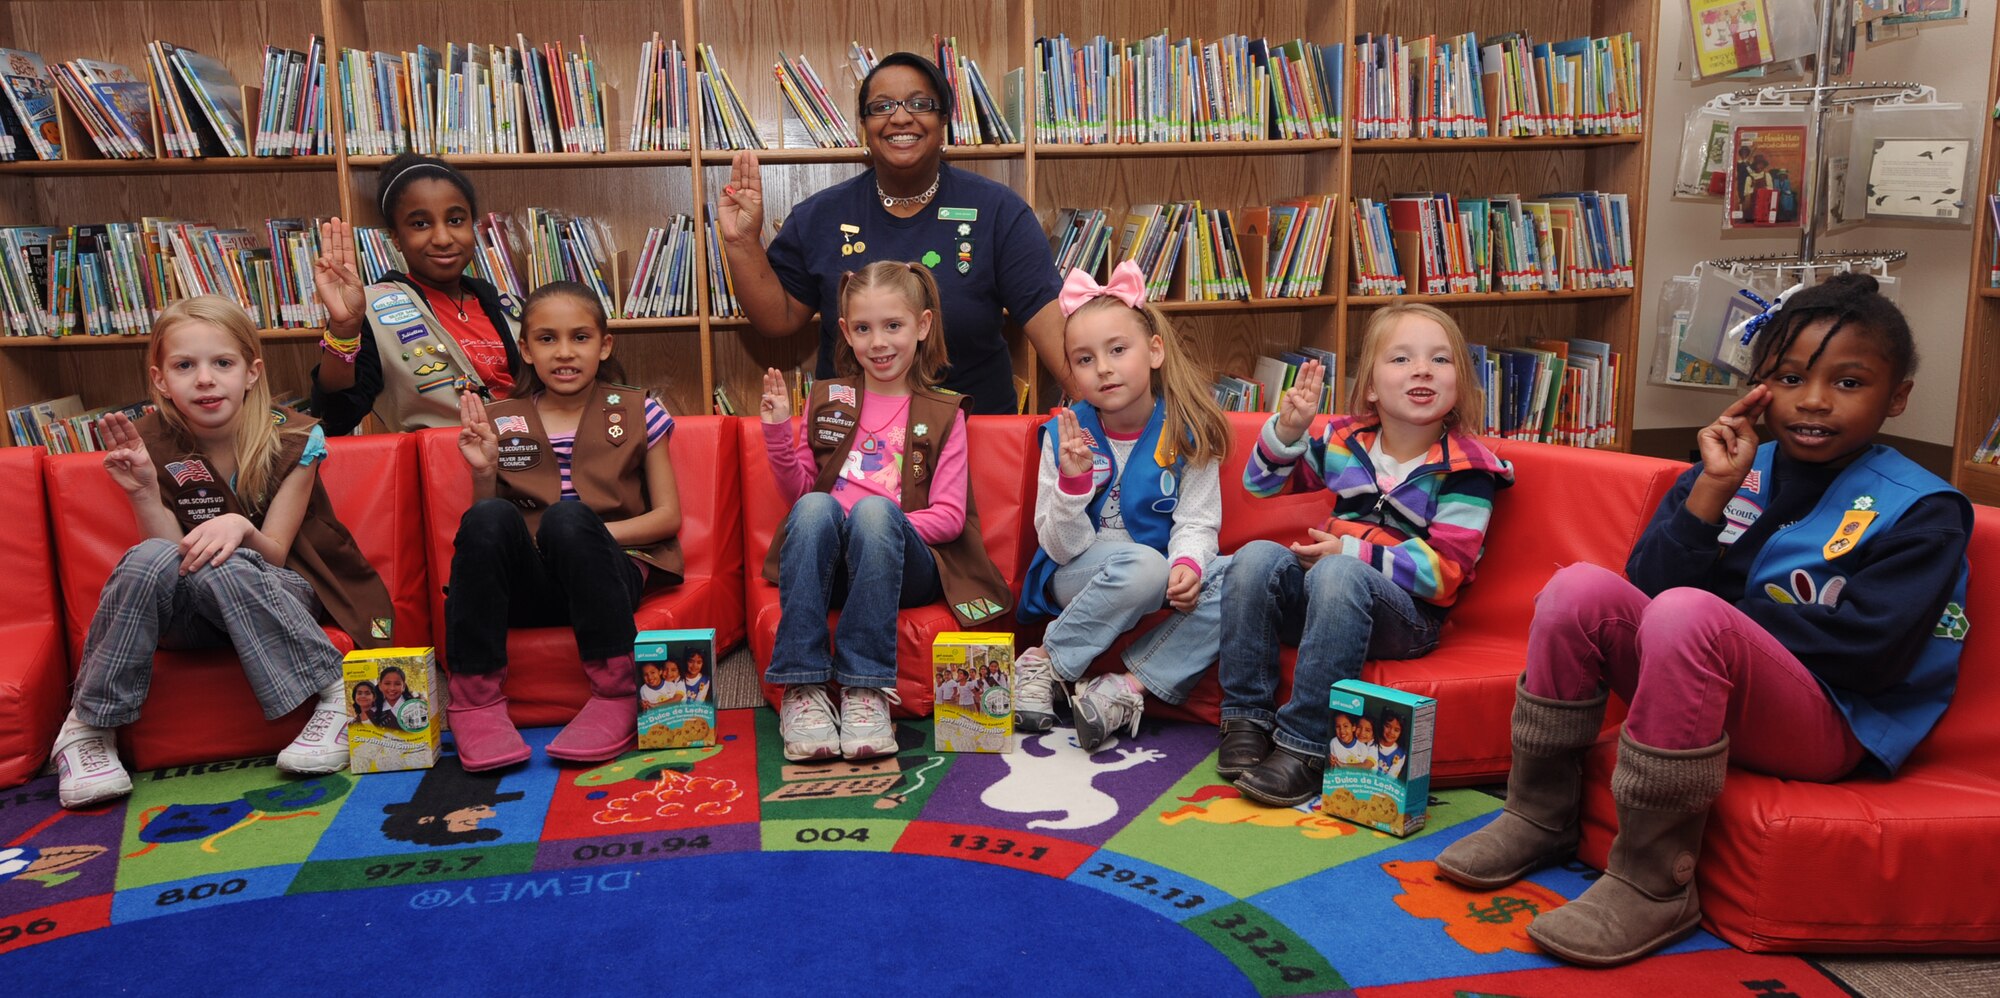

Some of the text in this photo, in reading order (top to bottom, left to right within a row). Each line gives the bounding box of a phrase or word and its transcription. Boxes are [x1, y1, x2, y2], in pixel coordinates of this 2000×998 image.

[826, 417, 845, 425] SCOUTS
[187, 508, 206, 516] SILVER
[191, 497, 214, 505] SCOUTS
[648, 711, 670, 722] Dulce
[685, 706, 708, 714] Leche
[352, 735, 426, 751] Savannah Smiles
[151, 755, 280, 782] Litera
[1334, 776, 1358, 784] Dulce
[1360, 776, 1372, 785] de
[1373, 779, 1400, 795] Leche
[795, 827, 870, 844] 004
[573, 835, 711, 861] 001.94
[949, 834, 1049, 861] 133.1
[364, 855, 484, 881] 973.7
[155, 878, 248, 907] 800
[1088, 862, 1208, 910] 292.13
[1211, 912, 1316, 984] 332.4
